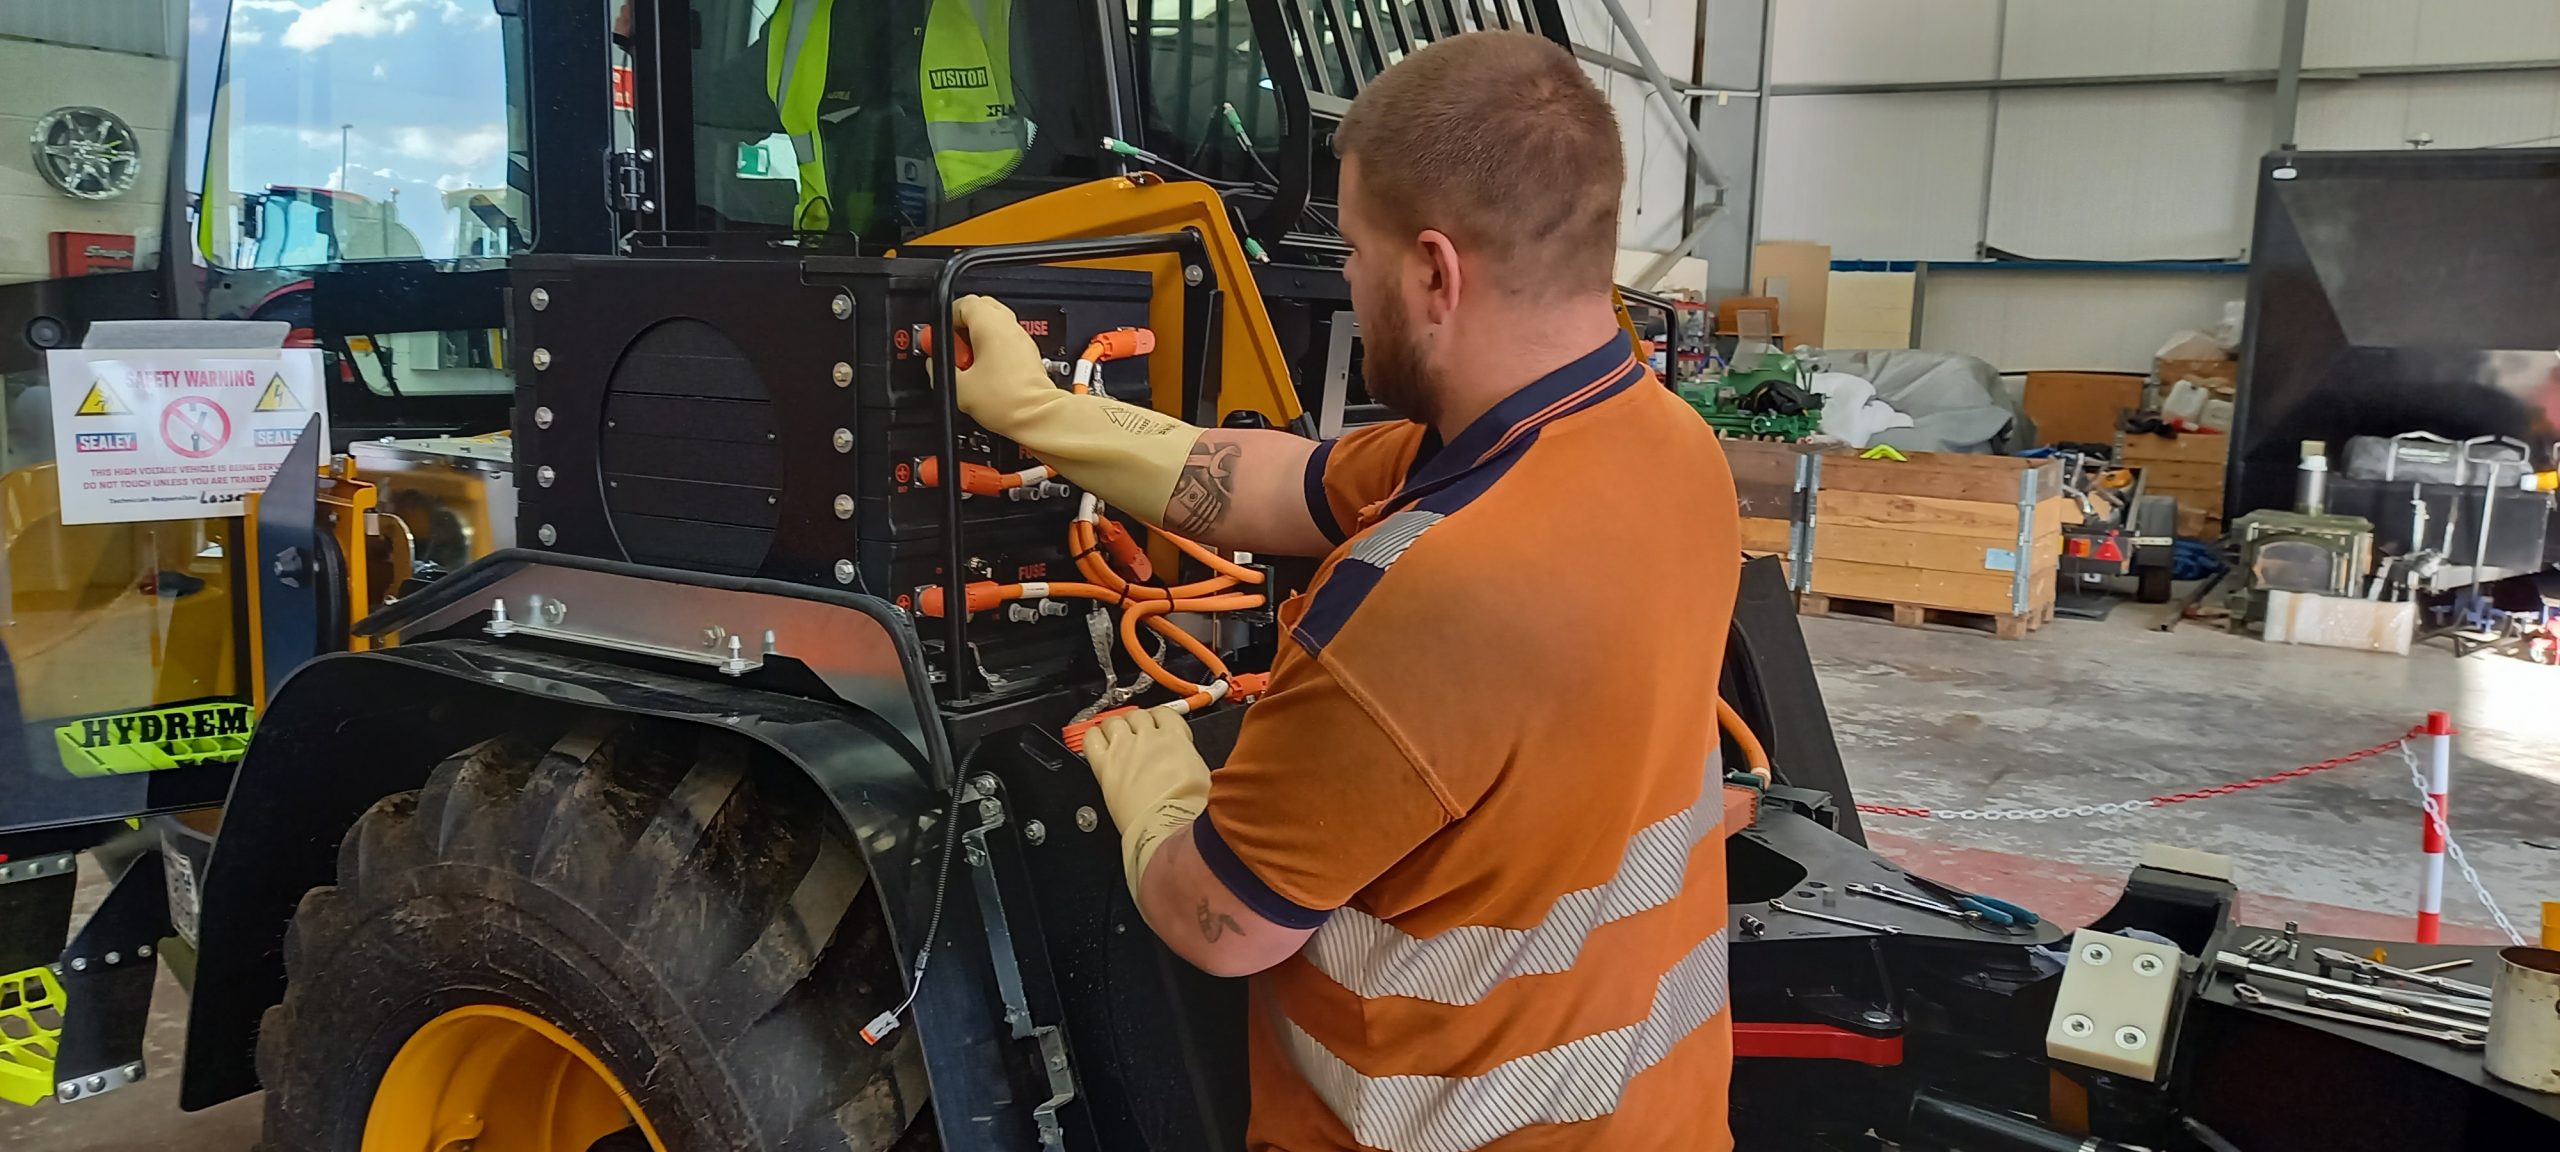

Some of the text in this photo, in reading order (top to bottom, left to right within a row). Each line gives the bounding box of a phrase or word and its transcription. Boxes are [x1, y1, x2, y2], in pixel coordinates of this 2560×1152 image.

[931, 68, 986, 88] VISITOR
[127, 369, 256, 388] SAFETY WARNING
[79, 434, 133, 450] SEALEY
[257, 430, 302, 445] SEALE
[90, 463, 281, 477] THIS HIGH VOLTAGE VEHICLE IS BEING SERV
[83, 482, 97, 490] DO
[99, 481, 117, 489] NOT
[120, 480, 151, 488] TOUCH
[153, 478, 188, 487] UNLESS
[211, 476, 228, 484] ARE
[230, 475, 267, 483] TRAINED
[1018, 563, 1047, 580] FUSE
[82, 706, 252, 748] HYDREM
